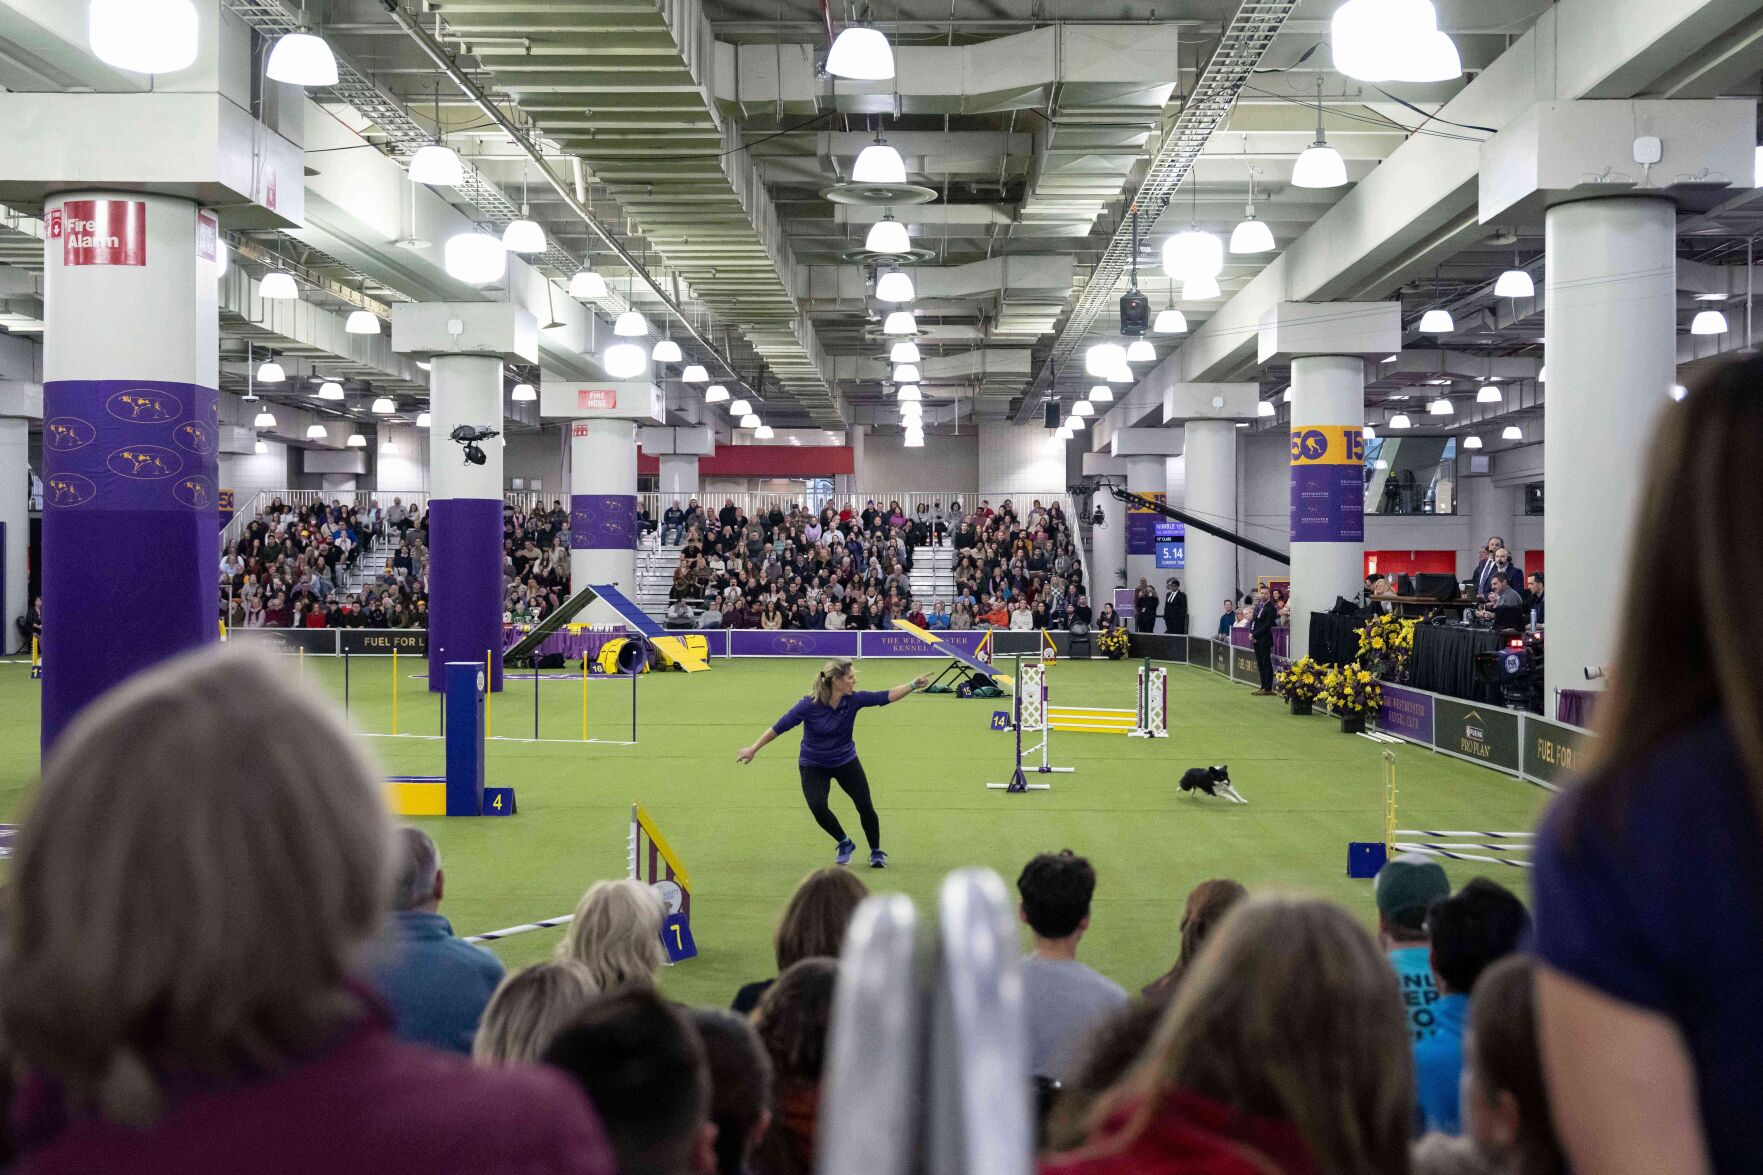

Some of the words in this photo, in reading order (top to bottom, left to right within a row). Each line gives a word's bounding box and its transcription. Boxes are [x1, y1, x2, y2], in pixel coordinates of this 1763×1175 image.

[67, 219, 97, 232] Fire
[589, 391, 605, 399] FIRE
[364, 637, 391, 646] FUEL
[394, 637, 416, 646] FOR
[893, 644, 929, 652] KENNEL
[963, 687, 972, 696] 15
[1393, 699, 1425, 717] WESTMINSTER
[993, 715, 1005, 727] 14
[1473, 740, 1489, 757] PLAN
[1537, 739, 1555, 763] FUEL
[1556, 745, 1572, 769] FOR
[493, 794, 503, 810] 4
[670, 924, 683, 950] 7
